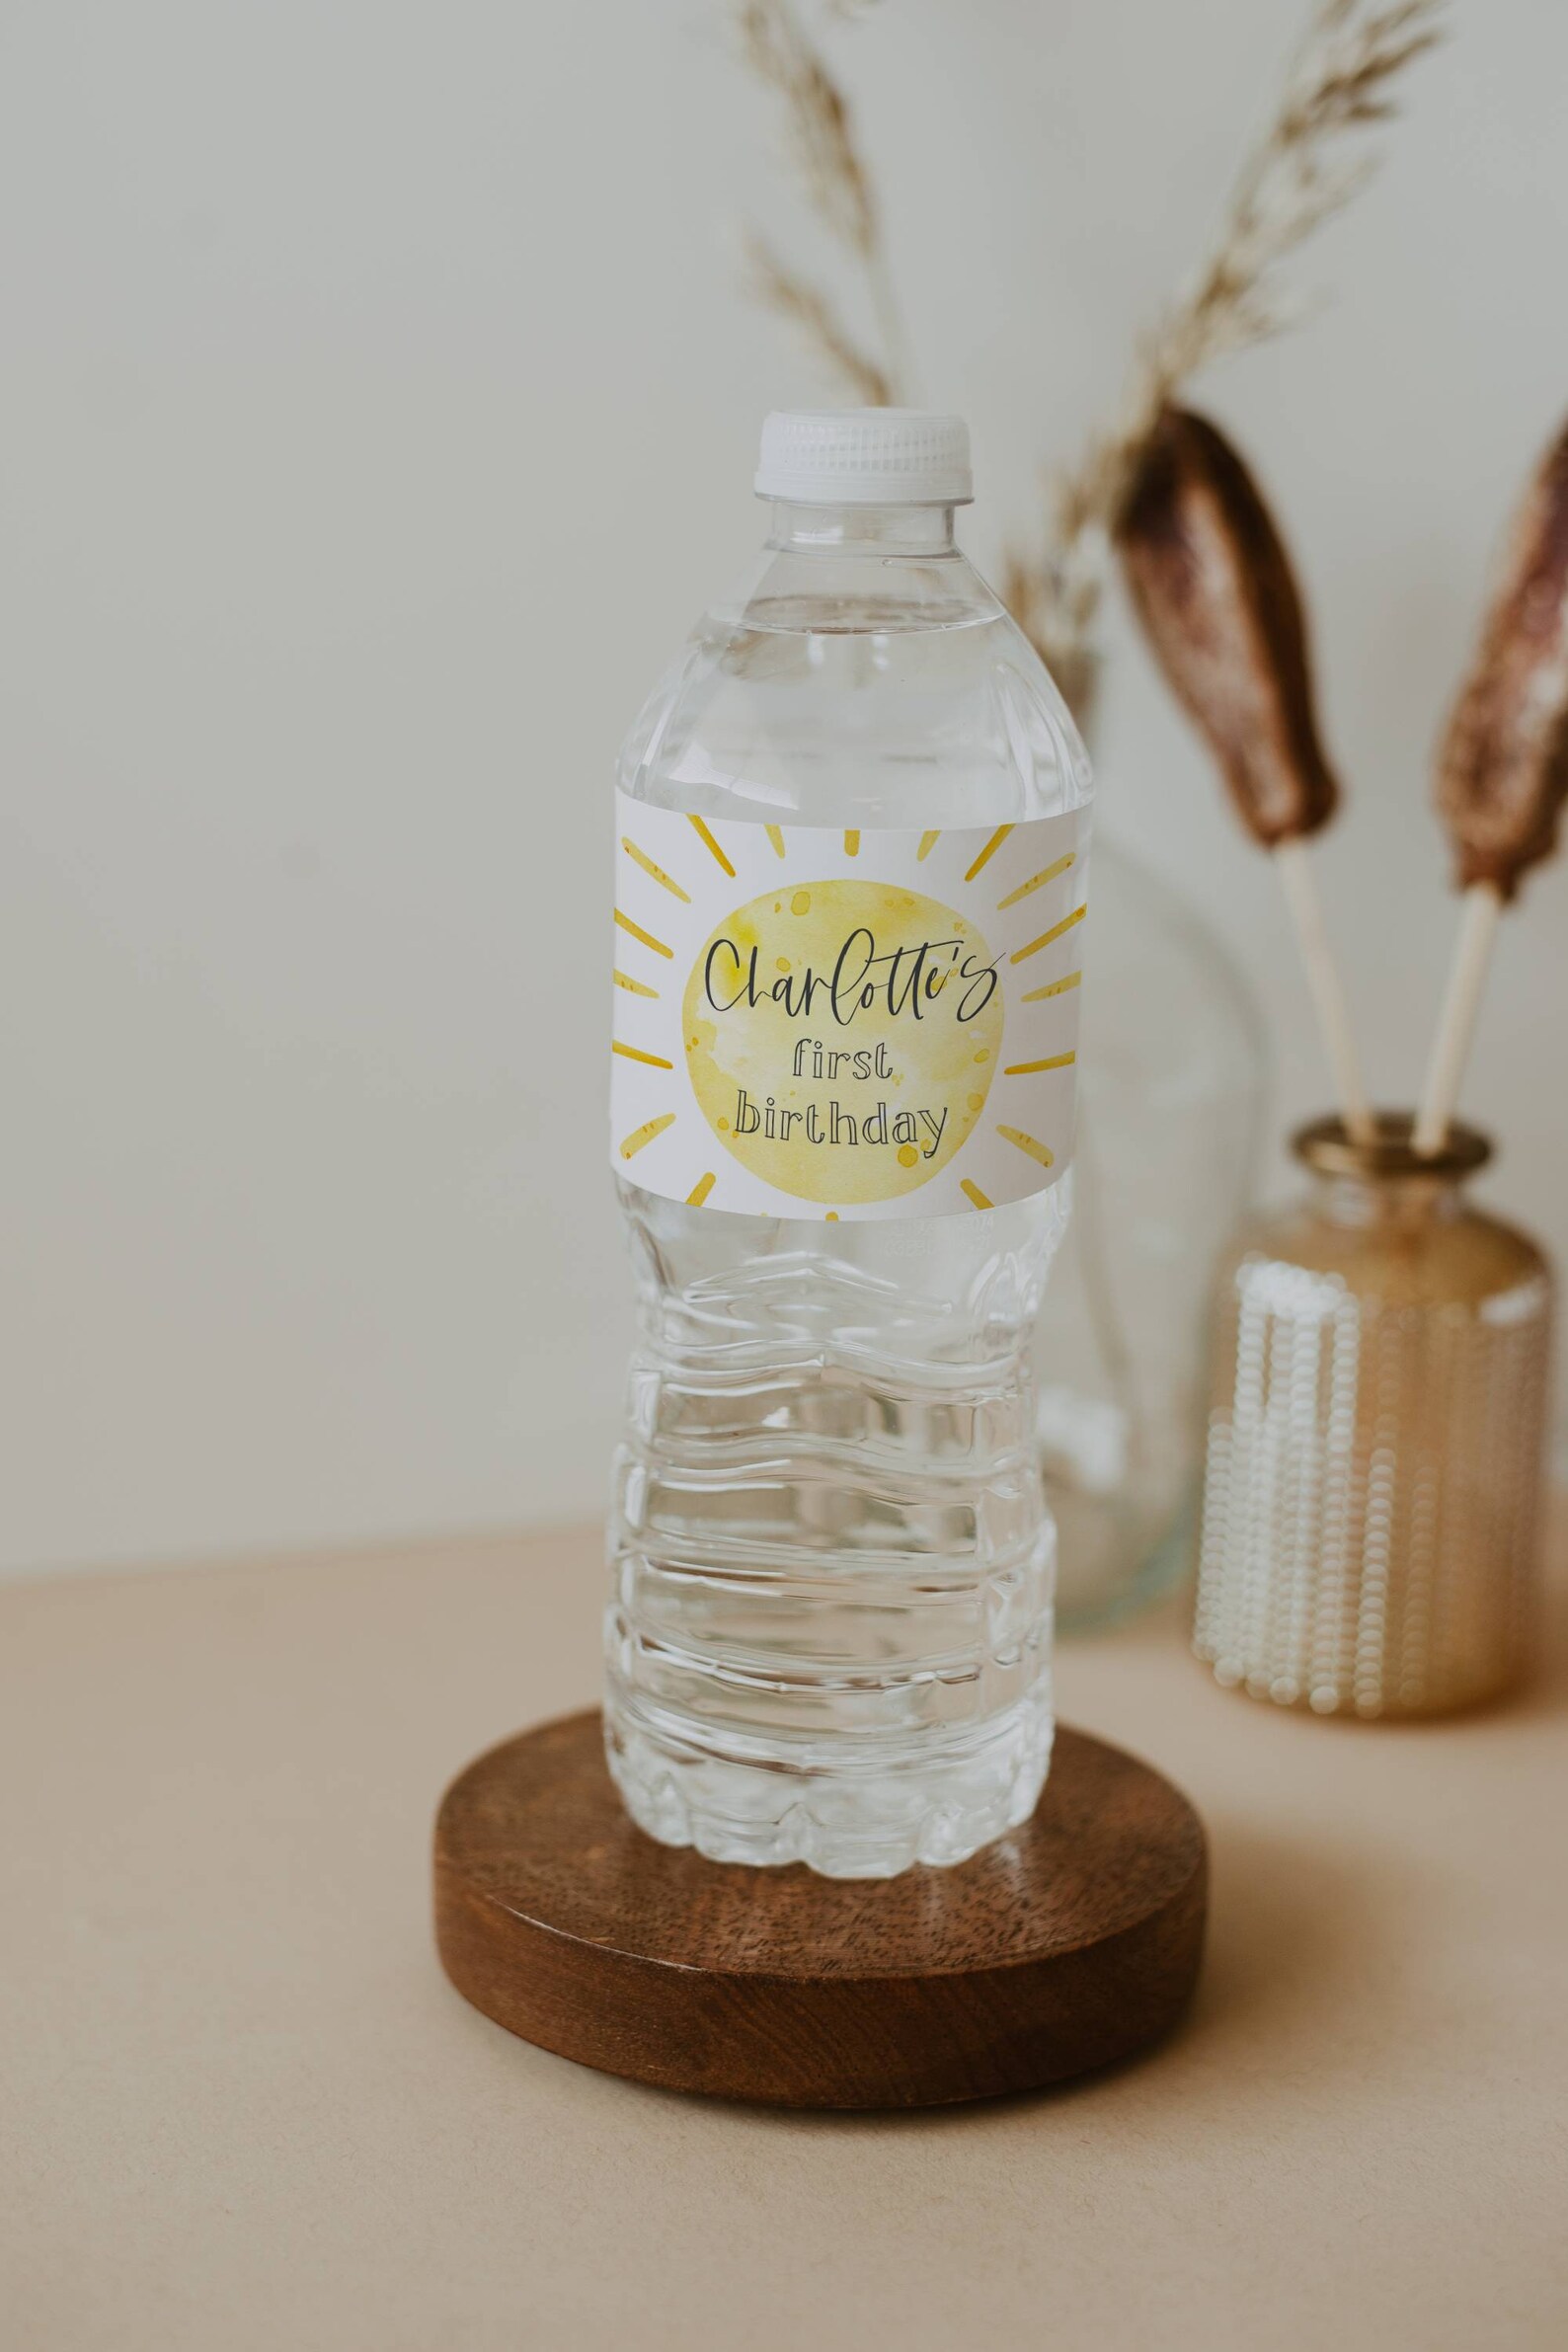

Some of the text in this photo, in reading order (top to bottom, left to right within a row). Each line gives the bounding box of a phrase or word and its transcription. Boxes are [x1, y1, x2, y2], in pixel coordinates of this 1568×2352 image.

[704, 928, 1007, 1026] Charlotte's
[792, 1038, 894, 1080] first
[734, 1089, 949, 1160] birthday
